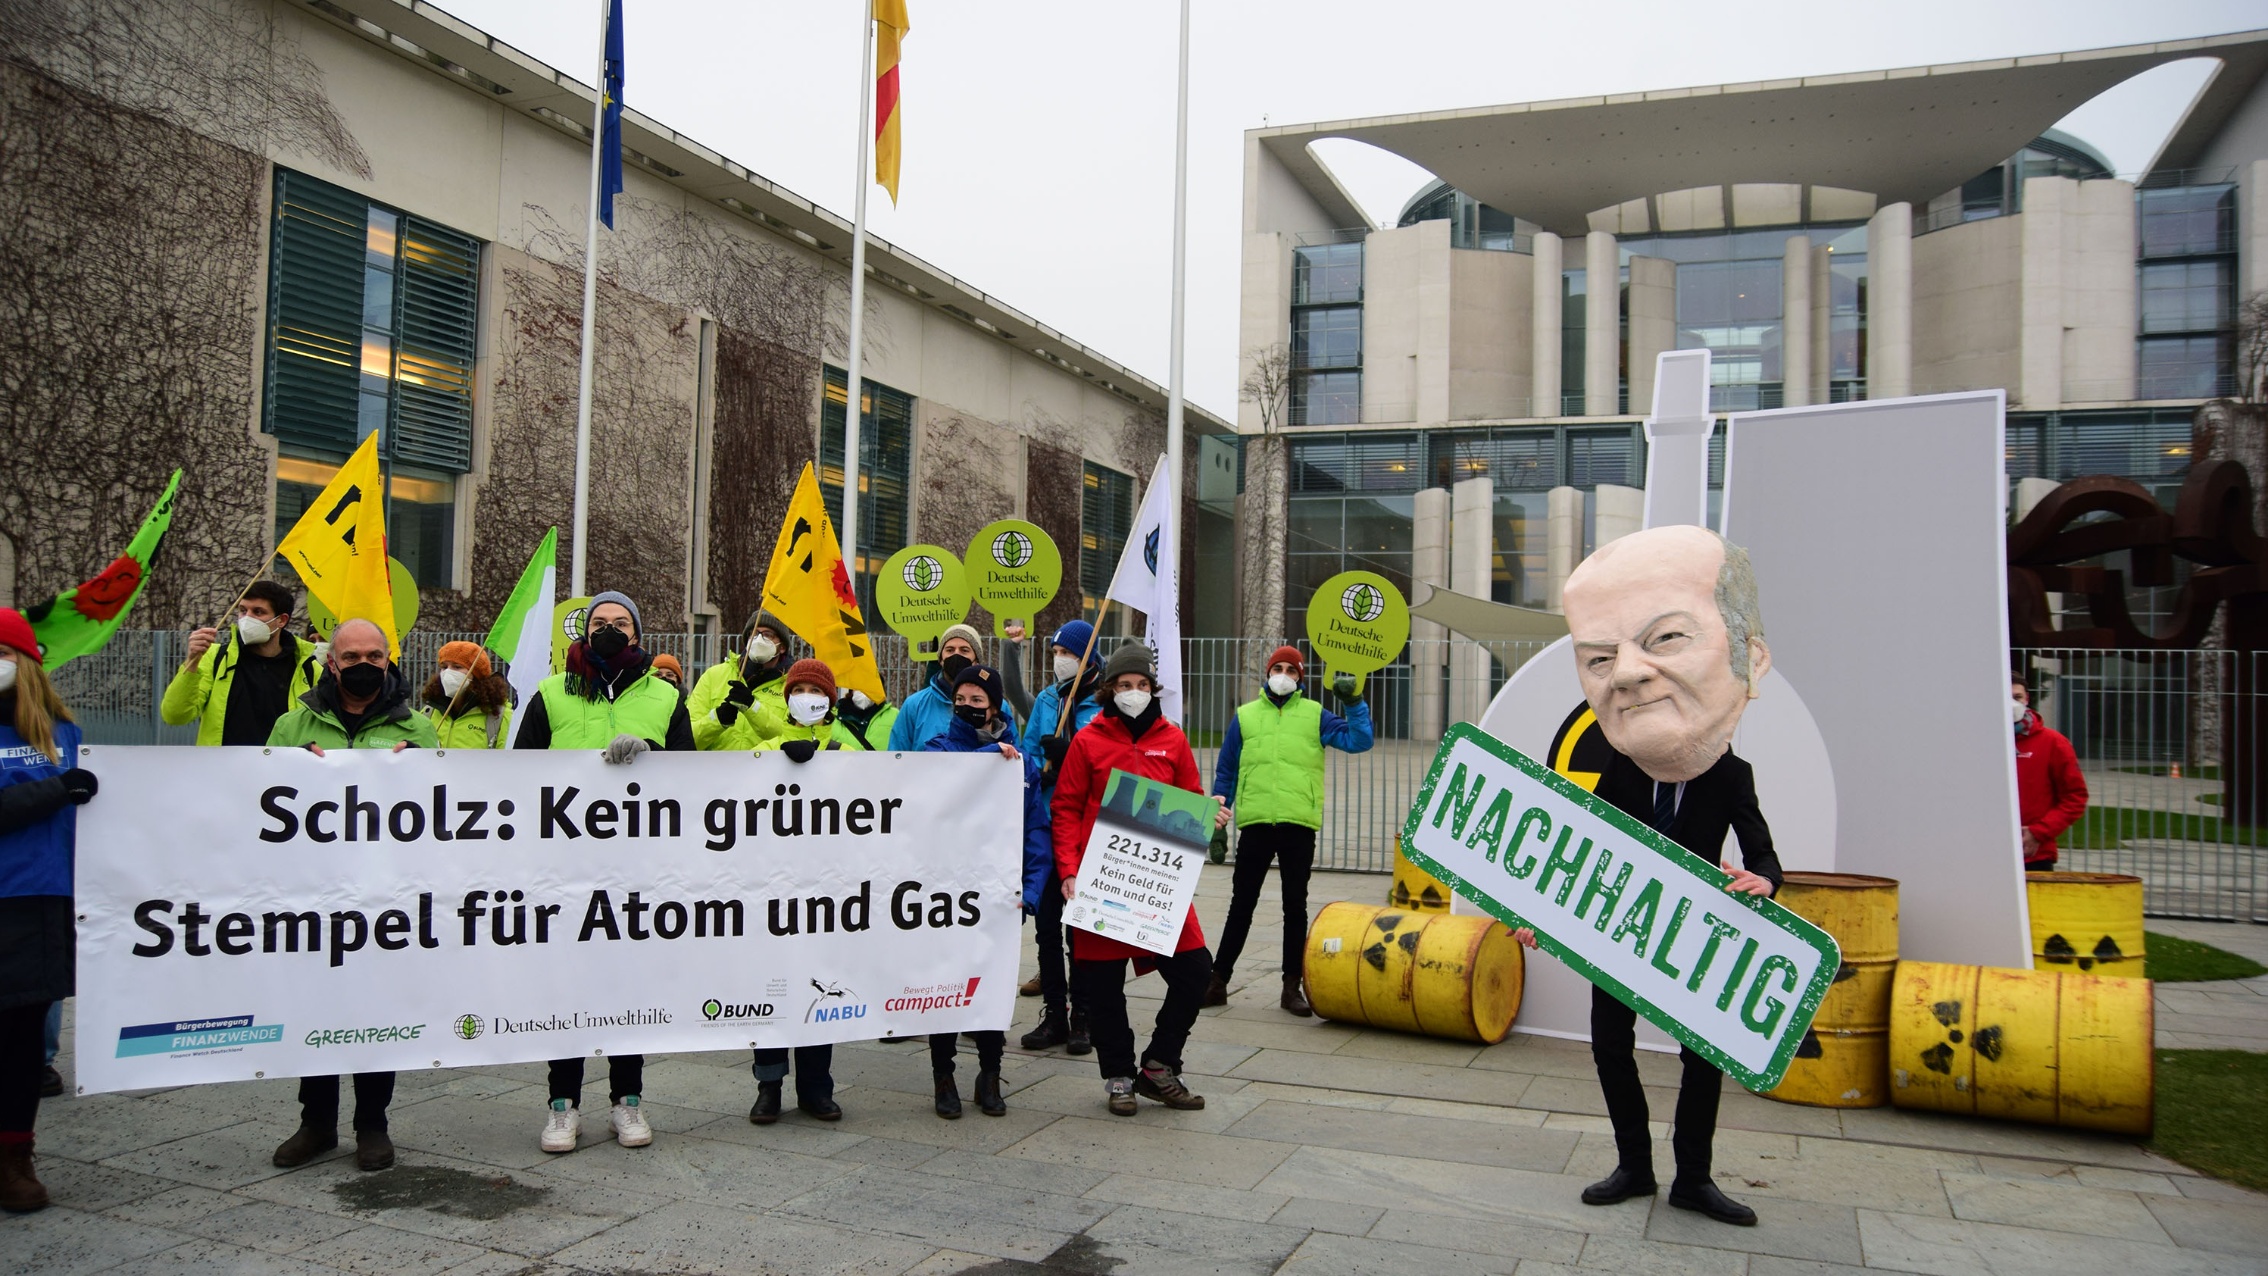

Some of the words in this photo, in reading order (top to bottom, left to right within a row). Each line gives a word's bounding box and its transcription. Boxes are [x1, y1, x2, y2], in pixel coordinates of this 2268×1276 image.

[987, 570, 1040, 583] Deutsche
[900, 594, 951, 608] Deutsche
[979, 587, 1048, 600] Umwelthilfe
[892, 609, 960, 624] Umwelthilfe
[1329, 618, 1383, 643] Deutsche
[1317, 632, 1388, 661] Umwelthilfe
[259, 784, 515, 843] Scholz:
[540, 782, 681, 839] Kein
[704, 783, 903, 852] grüner
[1107, 834, 1183, 871] 221.314
[1100, 865, 1126, 881] Kein
[1128, 874, 1154, 890] Geld
[1156, 882, 1174, 896] für
[1150, 868, 1179, 882] meinen:
[1090, 878, 1121, 895] Atom
[1123, 890, 1146, 903] und
[1148, 896, 1173, 912] Gas!
[1432, 761, 1799, 1042] NACHHALTIG
[132, 891, 439, 968] Stempel
[457, 889, 560, 946] für
[578, 889, 744, 942] Atom
[768, 880, 871, 936] und
[890, 880, 981, 931] Gas
[884, 976, 981, 1014] campact!
[903, 985, 934, 995] Bewegt
[937, 982, 965, 992] Politik
[493, 1014, 571, 1035] Deutsche
[573, 1008, 673, 1029] Umwelthilfe
[724, 1003, 774, 1018] BUND
[815, 1004, 867, 1023] NABU
[175, 1018, 249, 1032] Bürgerbewegung
[305, 1023, 426, 1048] GREENPEACE
[171, 1028, 278, 1048] FINANZWENDE
[210, 1047, 244, 1055] Deutschland
